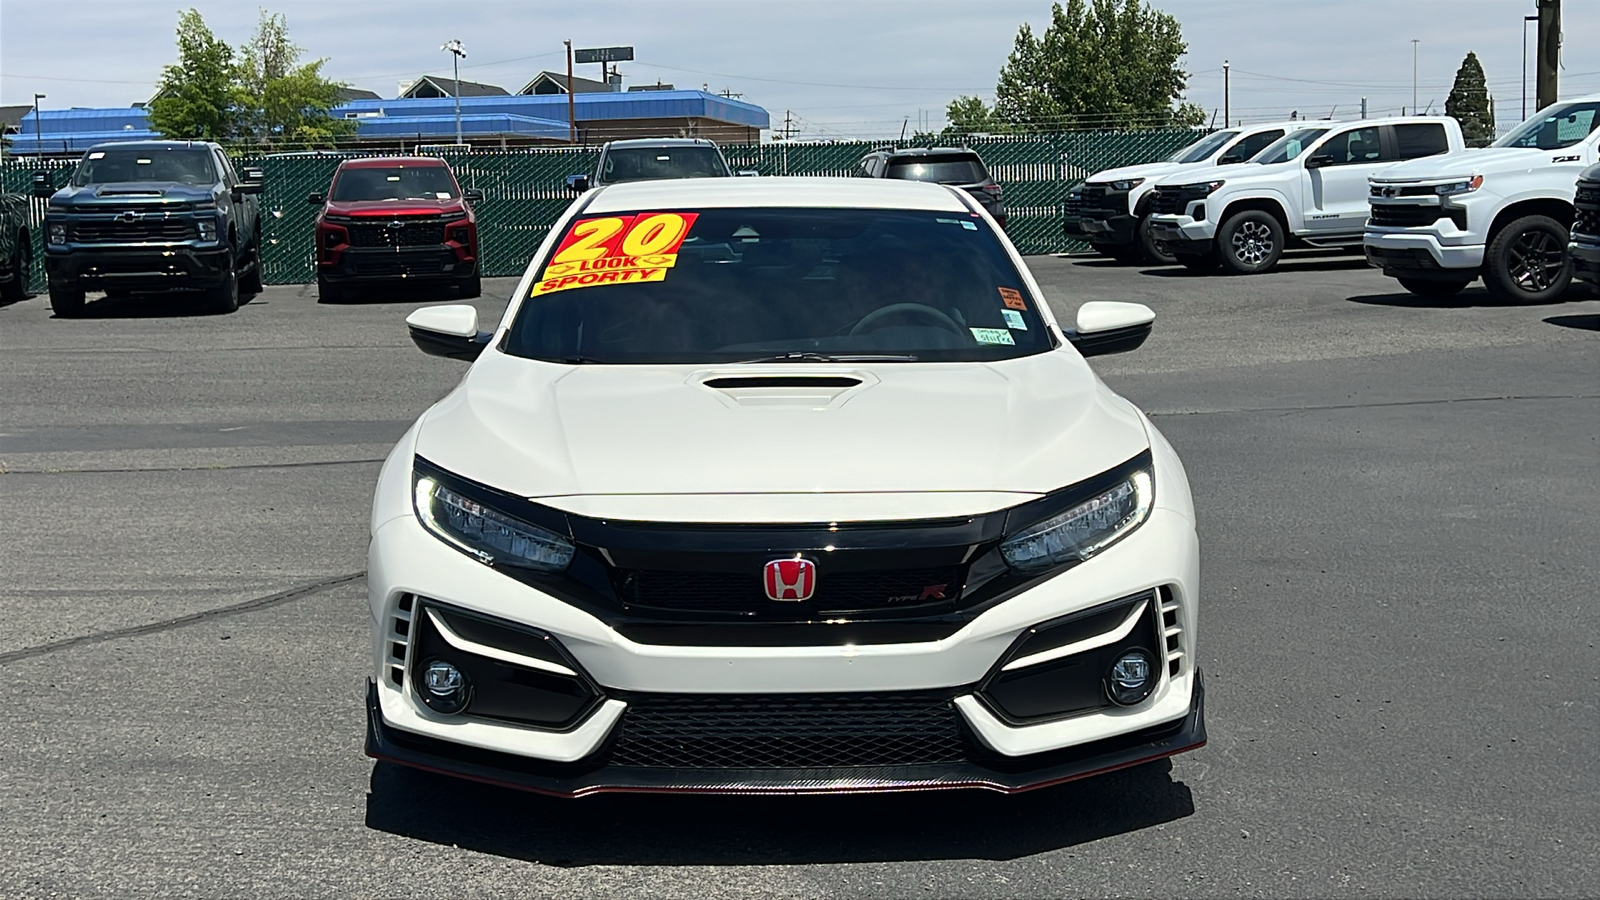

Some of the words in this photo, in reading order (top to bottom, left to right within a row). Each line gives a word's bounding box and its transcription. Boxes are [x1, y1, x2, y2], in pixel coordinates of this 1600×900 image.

[553, 213, 687, 264] 20
[579, 256, 640, 272] LOOK
[539, 269, 661, 292] SPORTY
[887, 594, 919, 603] TYPE
[918, 583, 948, 600] R
